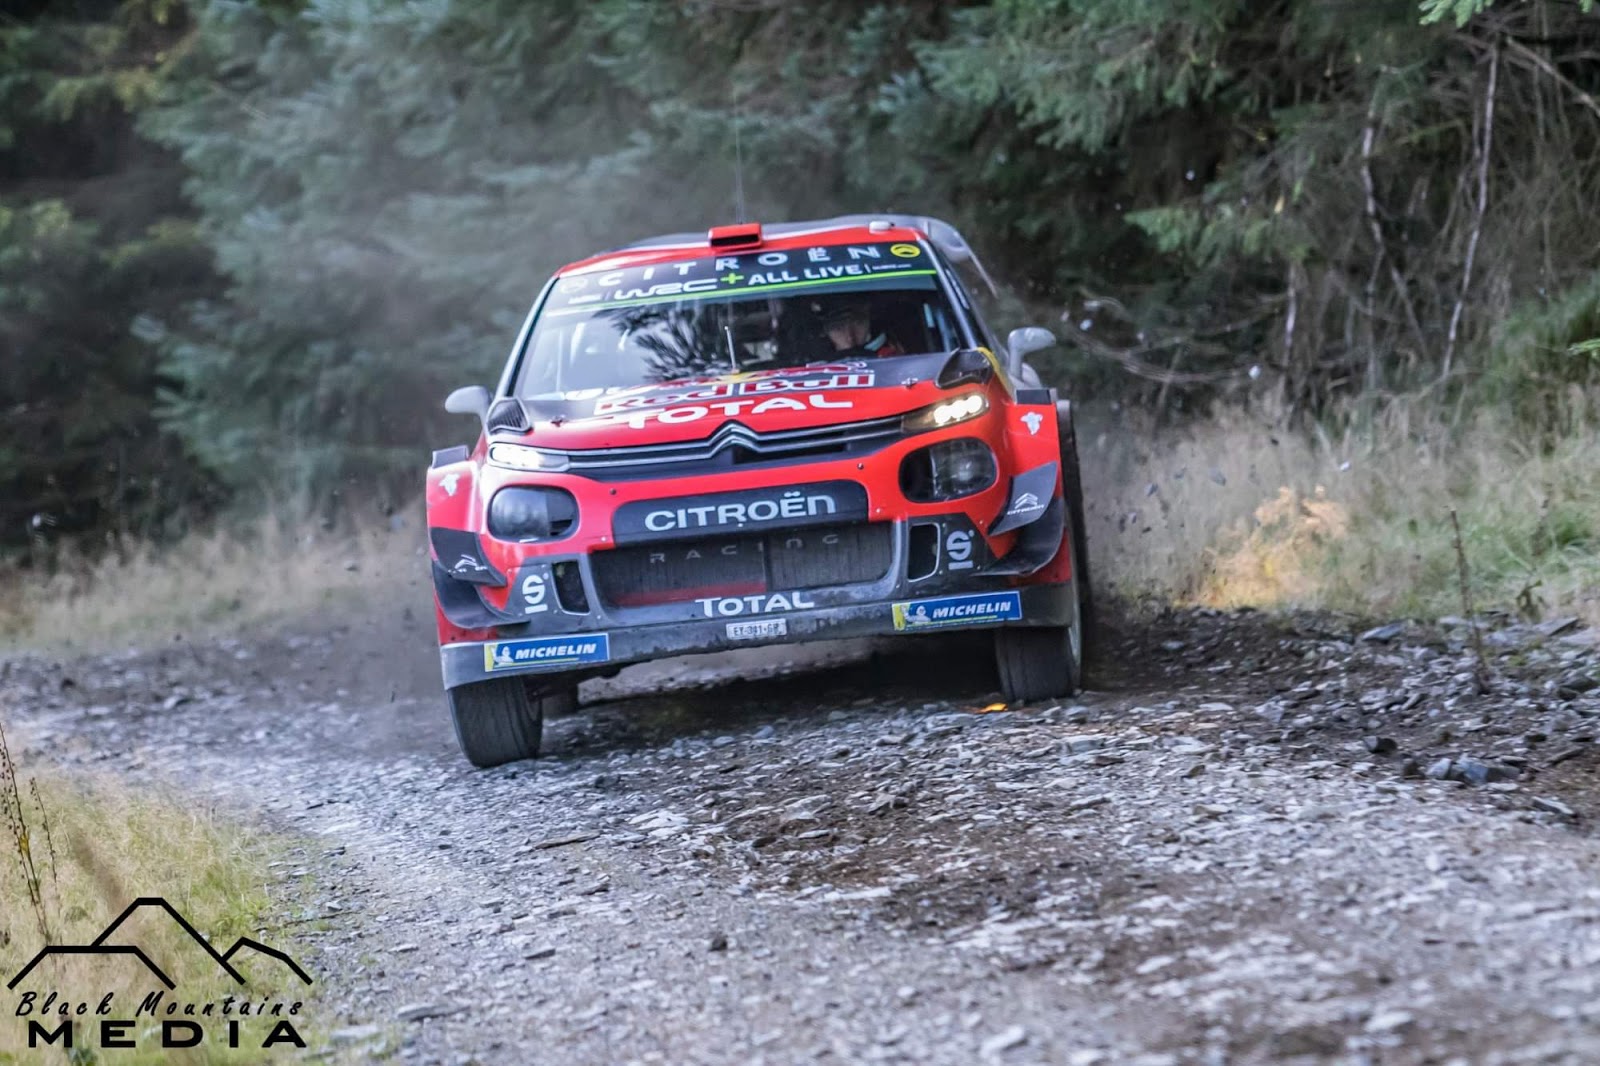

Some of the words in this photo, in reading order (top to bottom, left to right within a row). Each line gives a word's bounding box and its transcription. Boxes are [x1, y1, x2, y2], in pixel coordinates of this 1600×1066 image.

[598, 245, 881, 287] CITROËN
[748, 271, 798, 286] ALL
[803, 264, 863, 279] LIVE
[739, 374, 875, 397] Bull
[606, 394, 853, 430] TOTAL
[695, 592, 815, 618] TOTAL
[932, 601, 1012, 619] MICHELIN
[515, 643, 597, 660] MICHELIN
